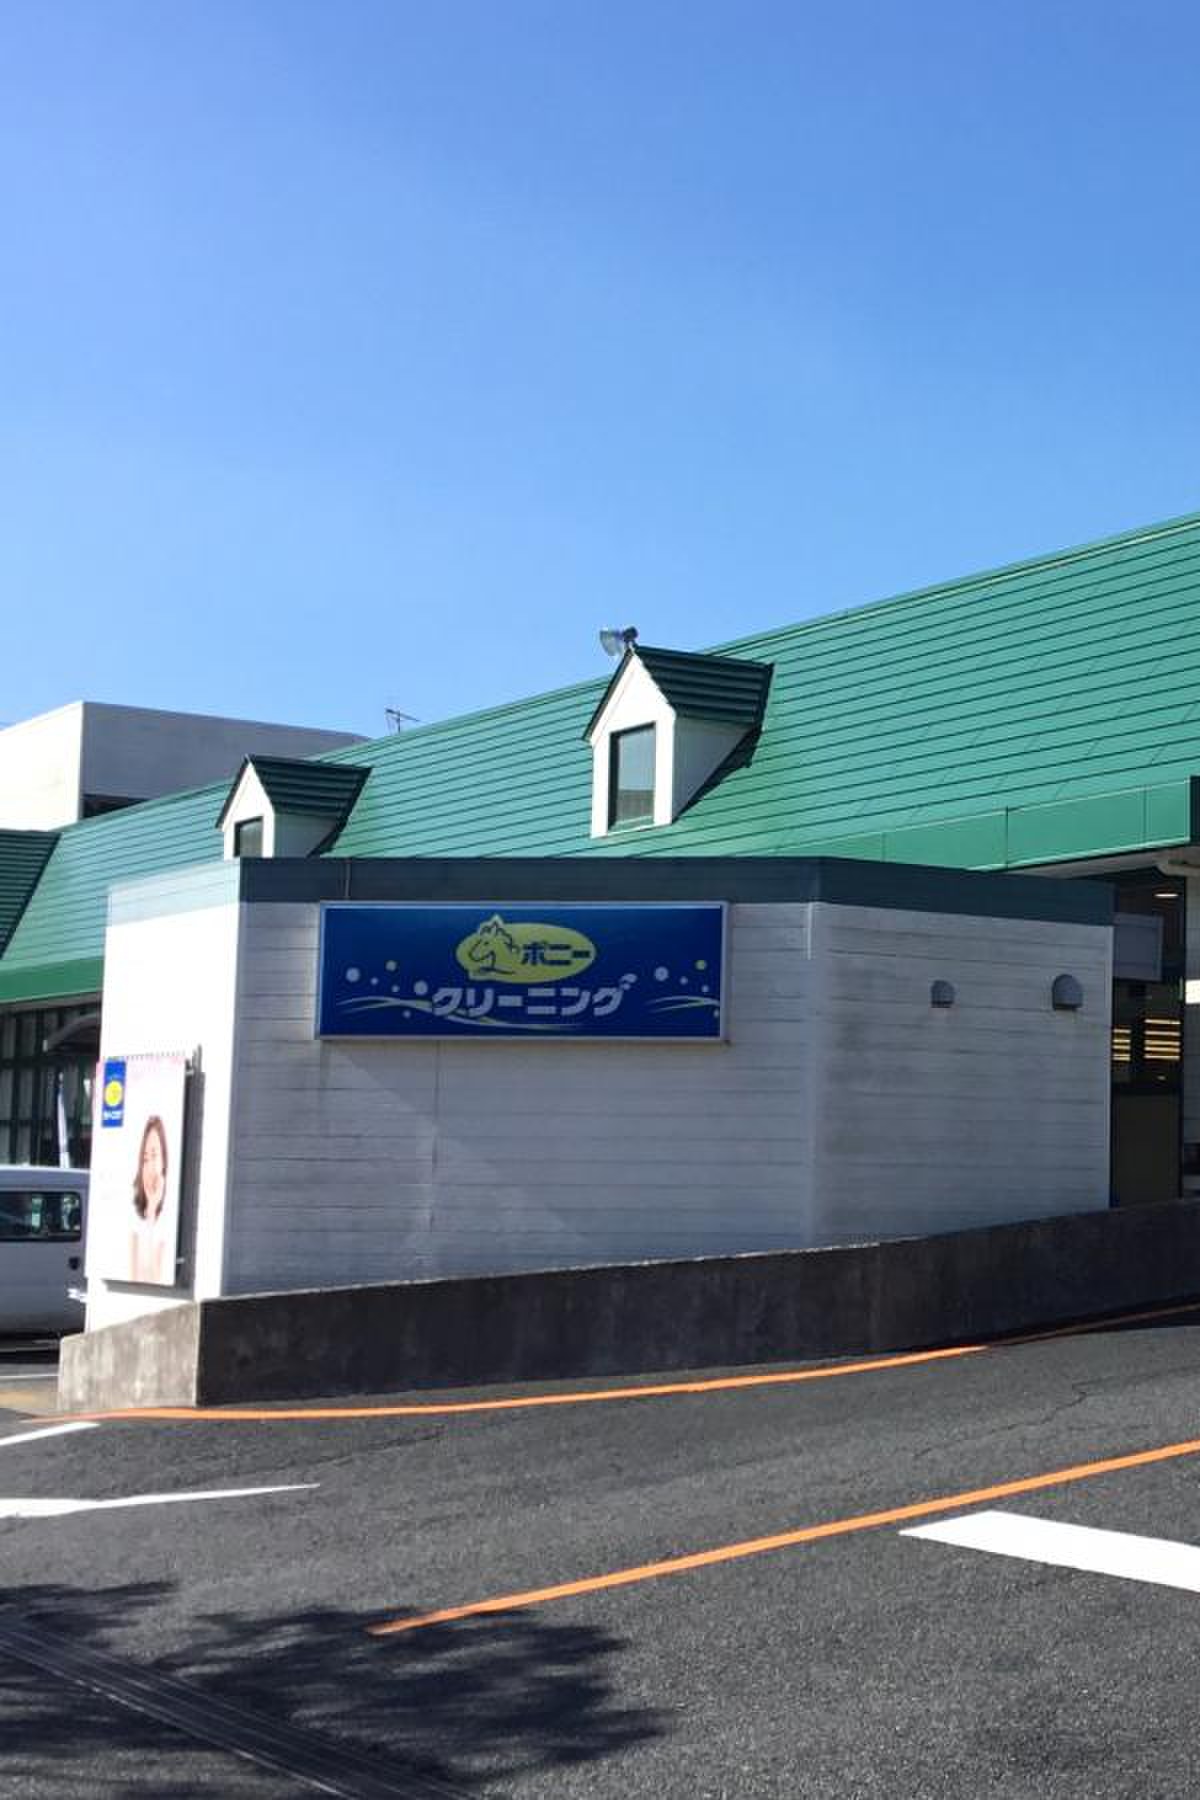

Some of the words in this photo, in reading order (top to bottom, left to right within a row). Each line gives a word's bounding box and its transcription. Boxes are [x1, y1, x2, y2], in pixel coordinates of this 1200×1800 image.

[431, 973, 637, 1016] クリーニング
